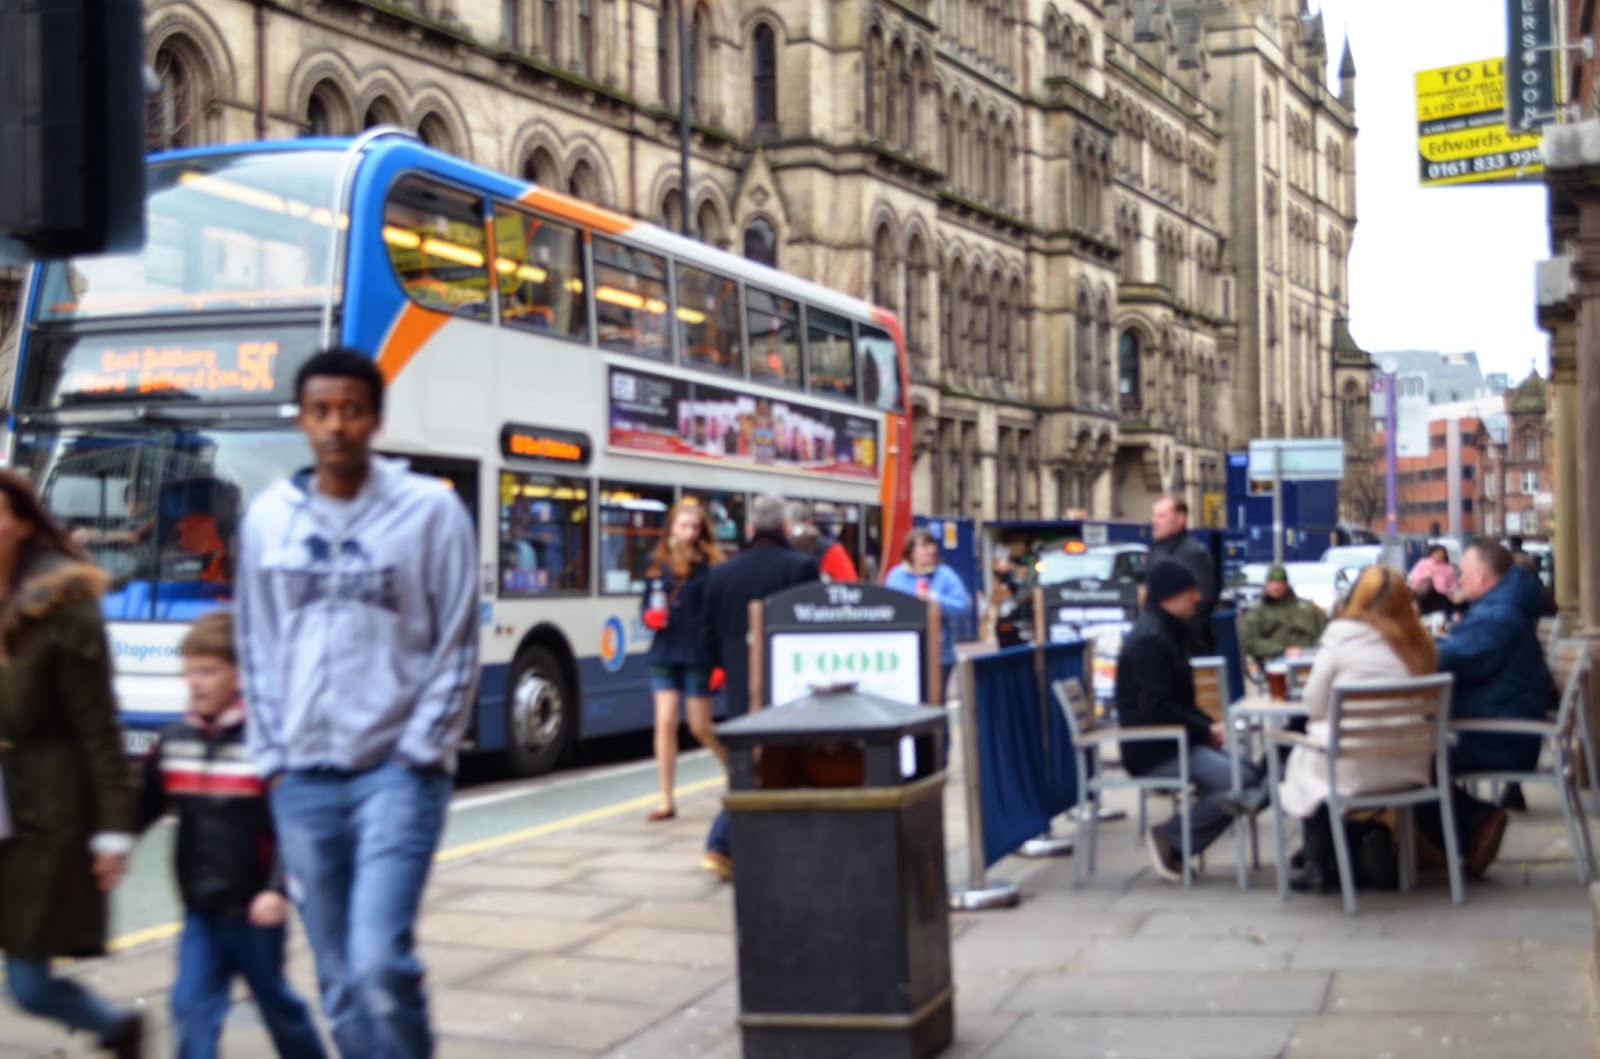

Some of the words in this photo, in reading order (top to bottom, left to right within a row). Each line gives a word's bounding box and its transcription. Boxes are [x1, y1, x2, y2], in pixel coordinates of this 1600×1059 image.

[1438, 66, 1472, 86] TO
[1428, 131, 1503, 156] Edwards
[1427, 160, 1467, 179] 0161
[1474, 154, 1505, 172] 833
[826, 585, 862, 604] The
[115, 640, 184, 661] Stagecoa
[792, 651, 899, 673] FOOD
